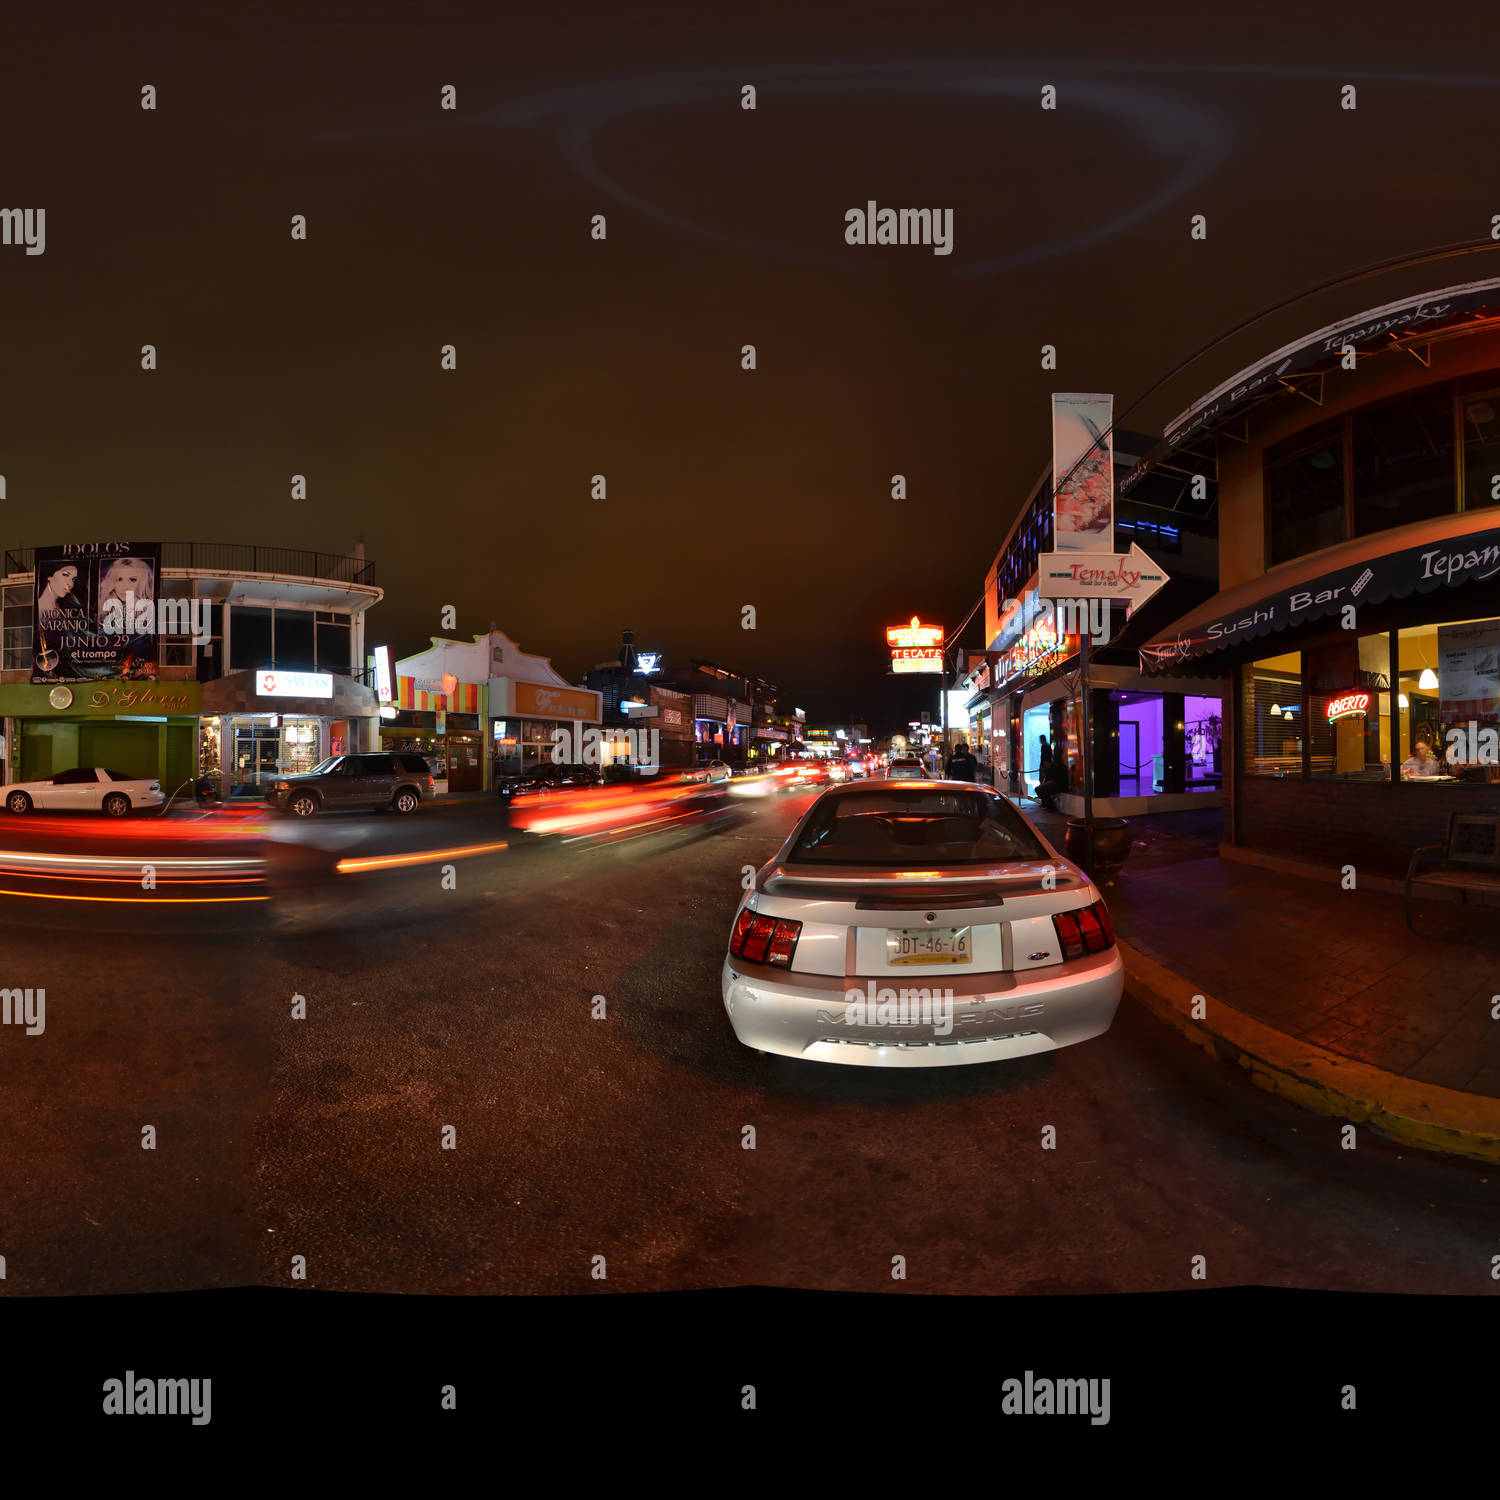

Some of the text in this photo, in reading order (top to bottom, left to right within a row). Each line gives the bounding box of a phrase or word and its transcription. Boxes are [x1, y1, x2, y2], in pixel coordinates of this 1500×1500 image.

[1231, 373, 1274, 401] Bar
[1070, 558, 1141, 592] Temaky
[1206, 605, 1276, 641] Sushi
[1288, 584, 1346, 613] Bar
[40, 618, 88, 633] NARANJO
[59, 634, 130, 650] JUNIO 29
[891, 648, 942, 659] TECATE
[71, 650, 117, 660] el trompo
[1327, 694, 1370, 718] ABIERTO
[816, 1001, 1048, 1030] MANG
